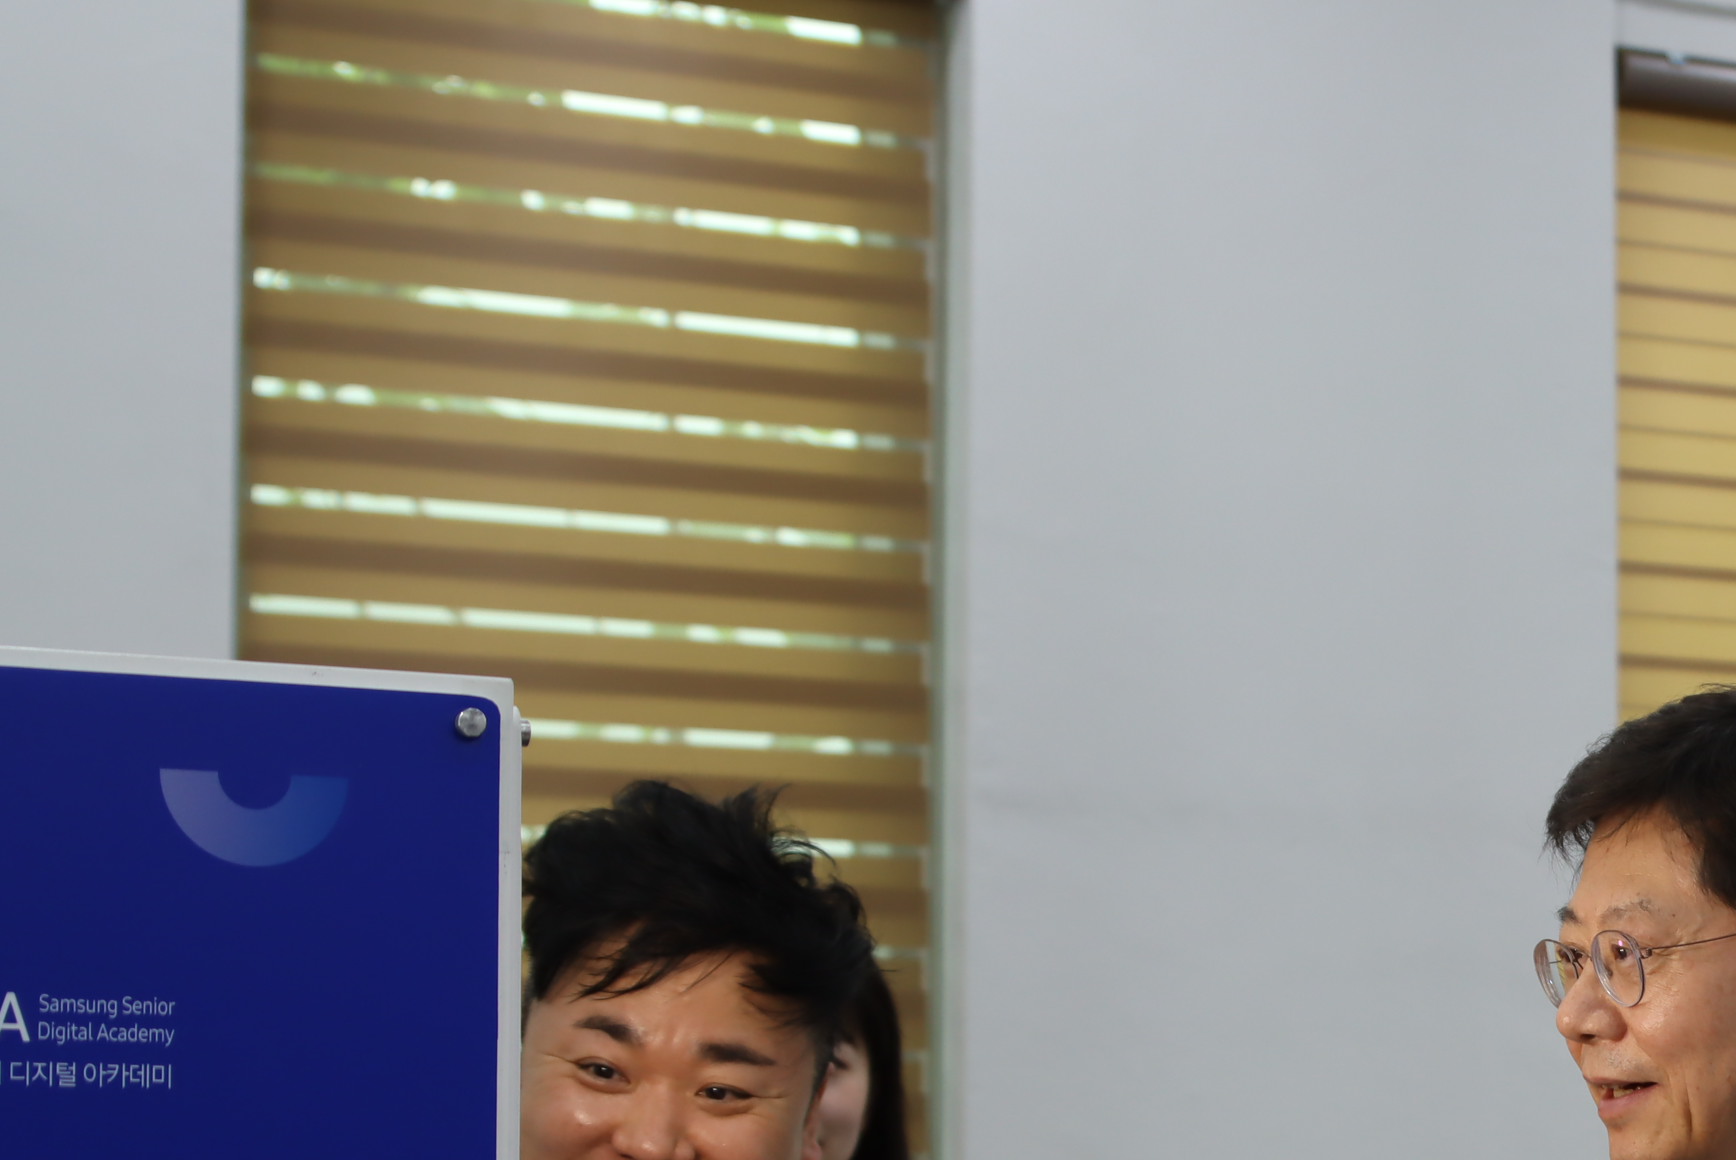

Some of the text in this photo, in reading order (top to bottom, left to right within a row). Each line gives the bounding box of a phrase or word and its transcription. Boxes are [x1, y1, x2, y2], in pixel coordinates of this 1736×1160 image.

[39, 993, 176, 1019] Samsung Senior
[38, 1021, 175, 1047] Digital Academy
[9, 1060, 77, 1088] 디지털
[83, 1062, 172, 1089] 아카데미
